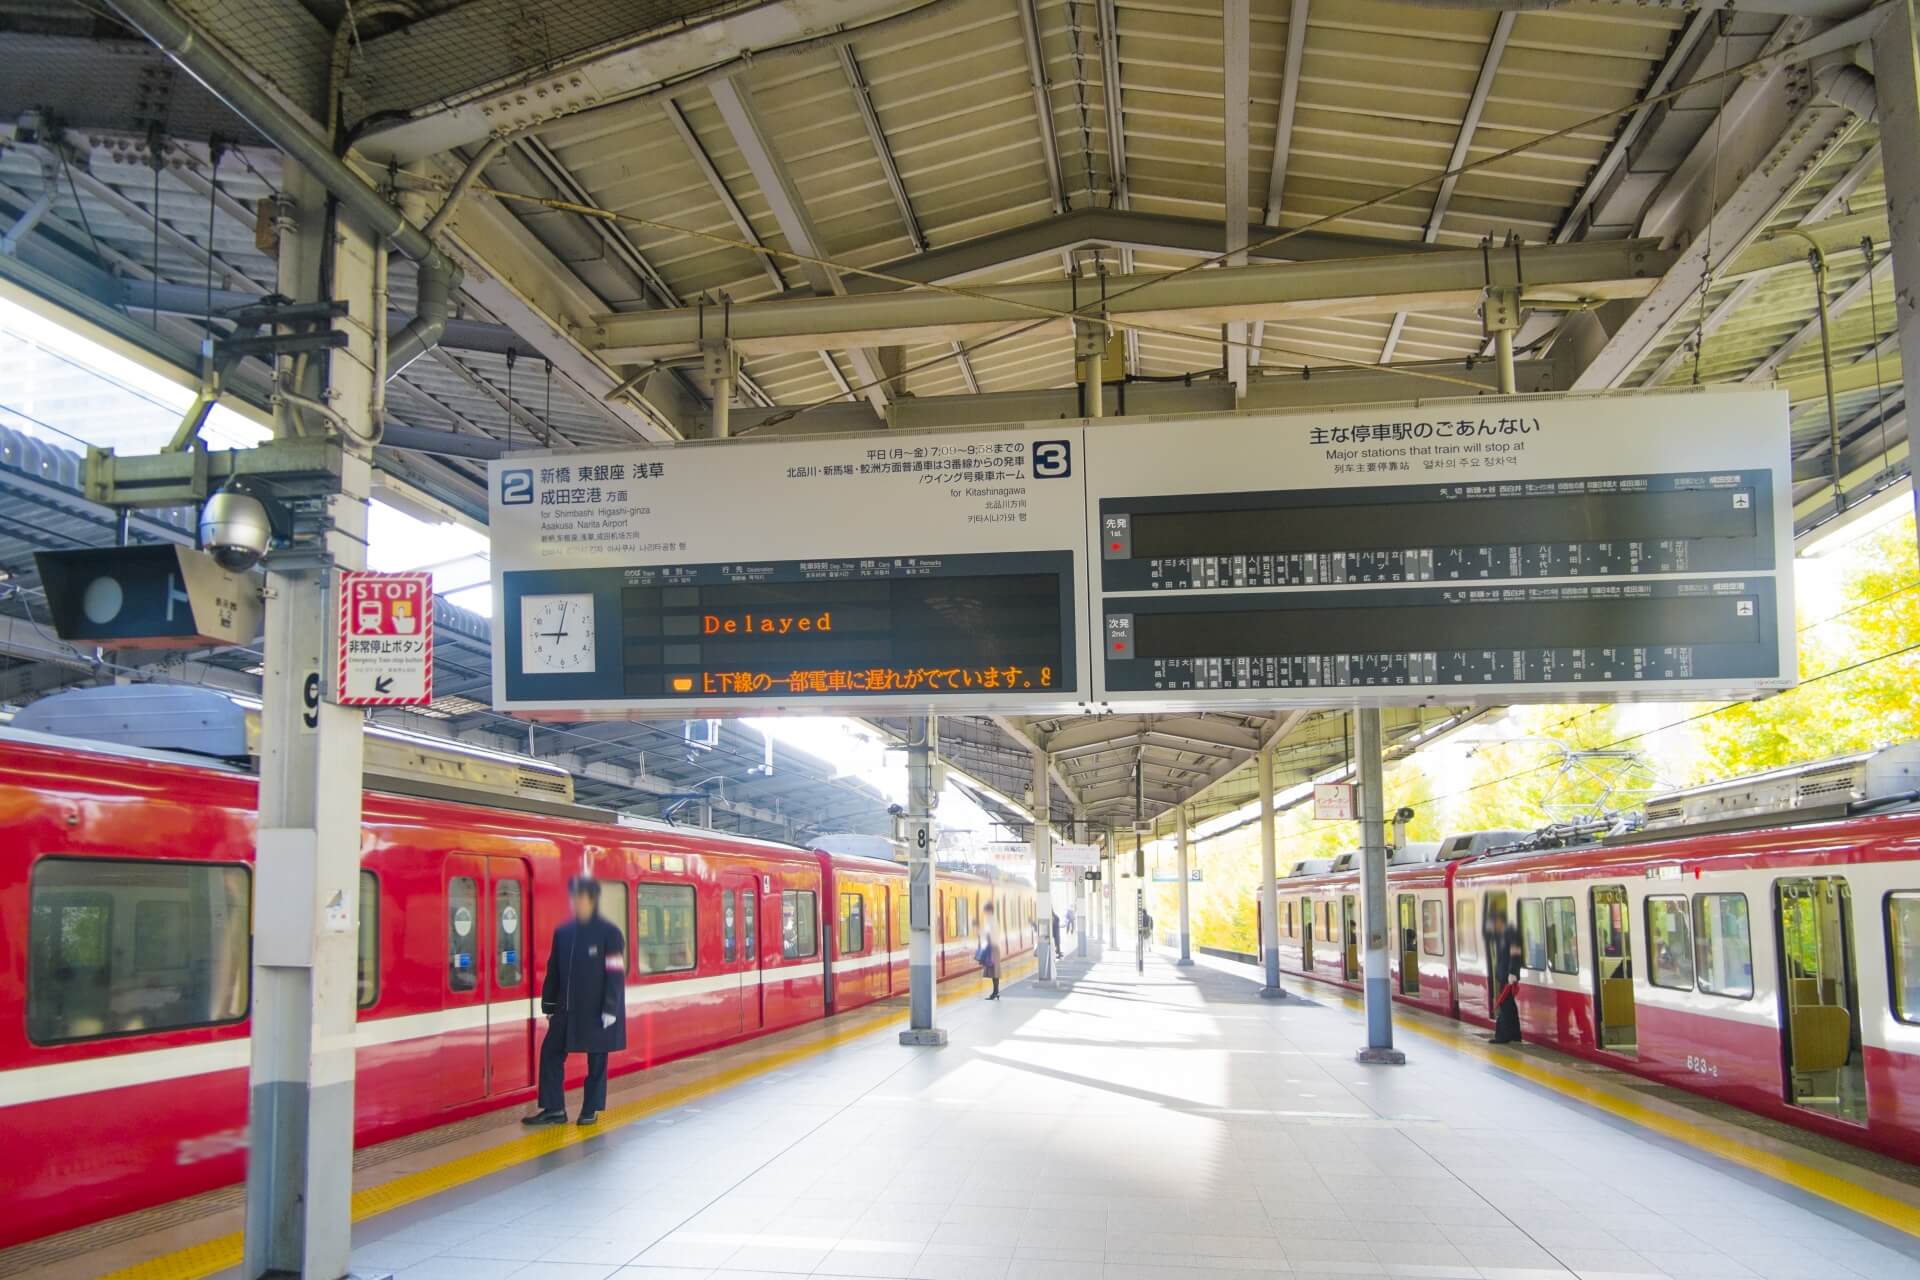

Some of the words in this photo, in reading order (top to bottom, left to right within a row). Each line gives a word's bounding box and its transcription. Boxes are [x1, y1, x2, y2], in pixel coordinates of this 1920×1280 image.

[1309, 418, 1541, 445] 主な停車駅のごあんない
[1035, 444, 1068, 476] 3
[1326, 450, 1358, 461] Major
[1361, 448, 1406, 458] stations
[1410, 446, 1432, 456] that
[1435, 445, 1460, 454] train
[1464, 444, 1482, 453] will
[1484, 442, 1510, 454] stop
[1513, 442, 1525, 450] at
[540, 467, 571, 484] 新橋
[578, 464, 625, 482] 東銀座
[632, 462, 665, 480] 浅草
[503, 472, 532, 503] 2
[540, 488, 602, 505] 成田空港
[606, 490, 628, 502] 方面
[950, 488, 962, 497] for
[966, 487, 1026, 498] Kitashinagawa
[554, 510, 594, 518] Shimbashi
[598, 507, 650, 518] Higashi-ginza
[541, 521, 573, 530] Asakusa
[577, 520, 600, 528] Narita
[602, 519, 628, 528] Airport
[1106, 518, 1128, 529] 先発
[356, 584, 417, 599] STOP
[704, 612, 832, 634] Delayed
[1109, 618, 1130, 629] 次発
[350, 640, 424, 654] 非常停止ボタン
[304, 672, 320, 728] 9
[918, 829, 925, 848] 8
